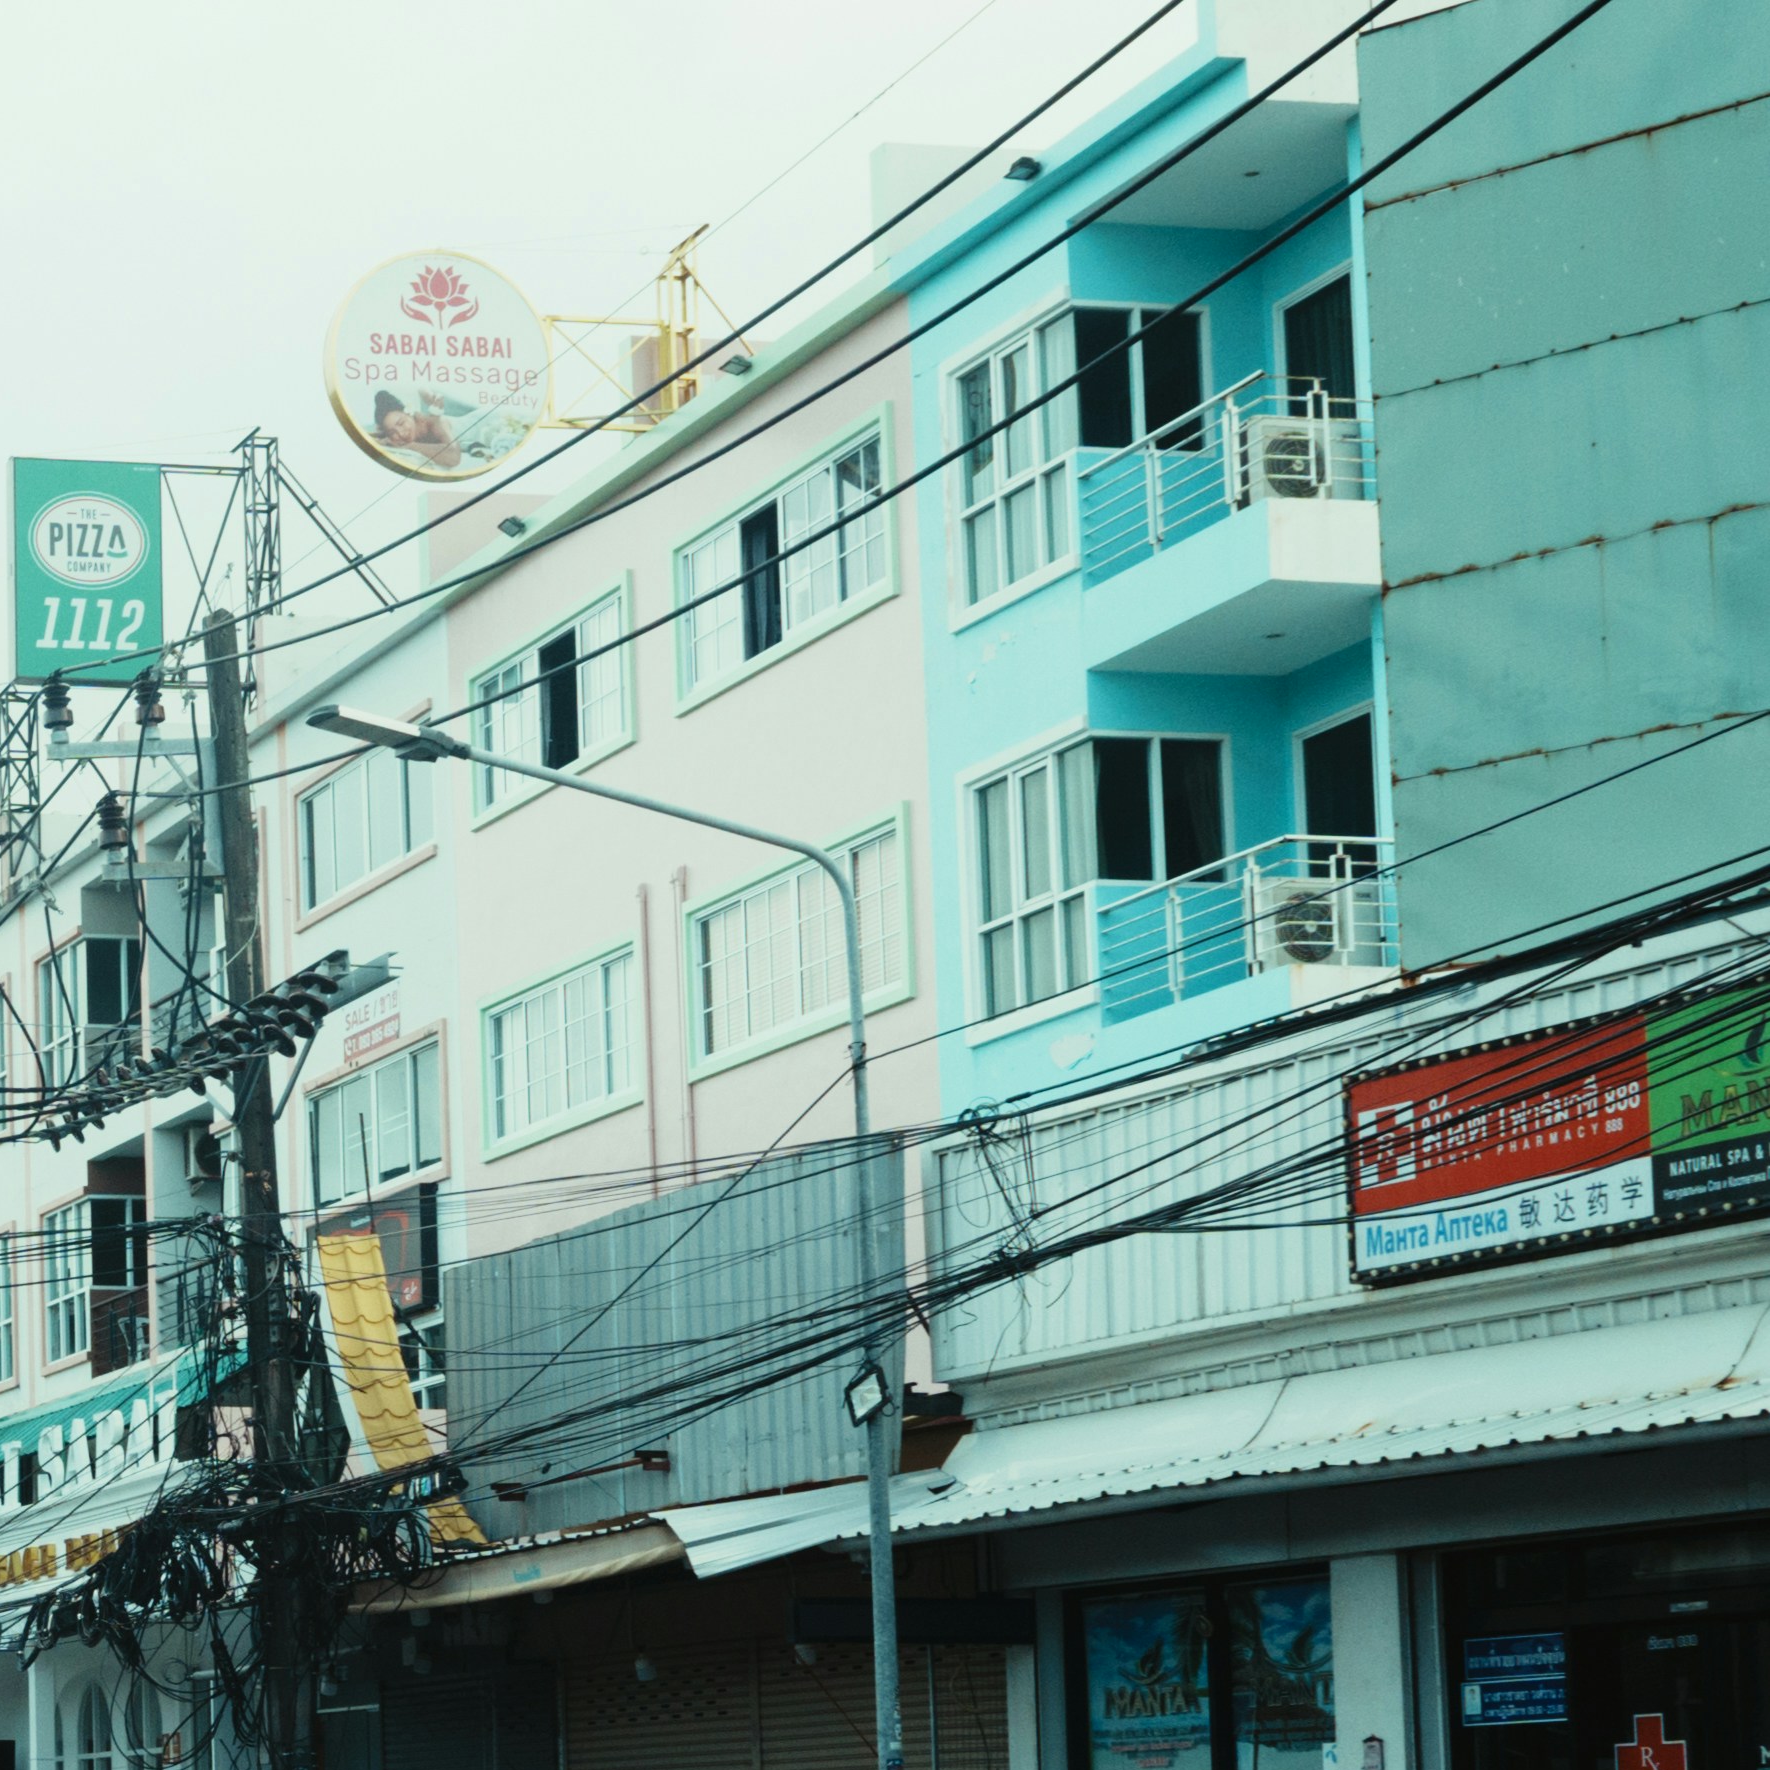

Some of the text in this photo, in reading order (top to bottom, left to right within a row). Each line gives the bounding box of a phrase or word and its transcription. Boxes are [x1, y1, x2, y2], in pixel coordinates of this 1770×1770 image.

[370, 333, 512, 359] SABAI SABAI
[345, 358, 539, 392] Spa Massage
[478, 391, 539, 409] Beauty
[80, 508, 97, 520] THE
[49, 522, 129, 559] PIZZA
[66, 561, 111, 574] COMPANY
[35, 597, 146, 651] 1112
[345, 1004, 370, 1032] SALE
[1497, 1123, 1598, 1156] PHARMACY
[1669, 1144, 1764, 1177] NATURAL SPA &
[1366, 1175, 1643, 1258] Манта Аптека 敏达药学
[37, 1389, 179, 1504] SABAI
